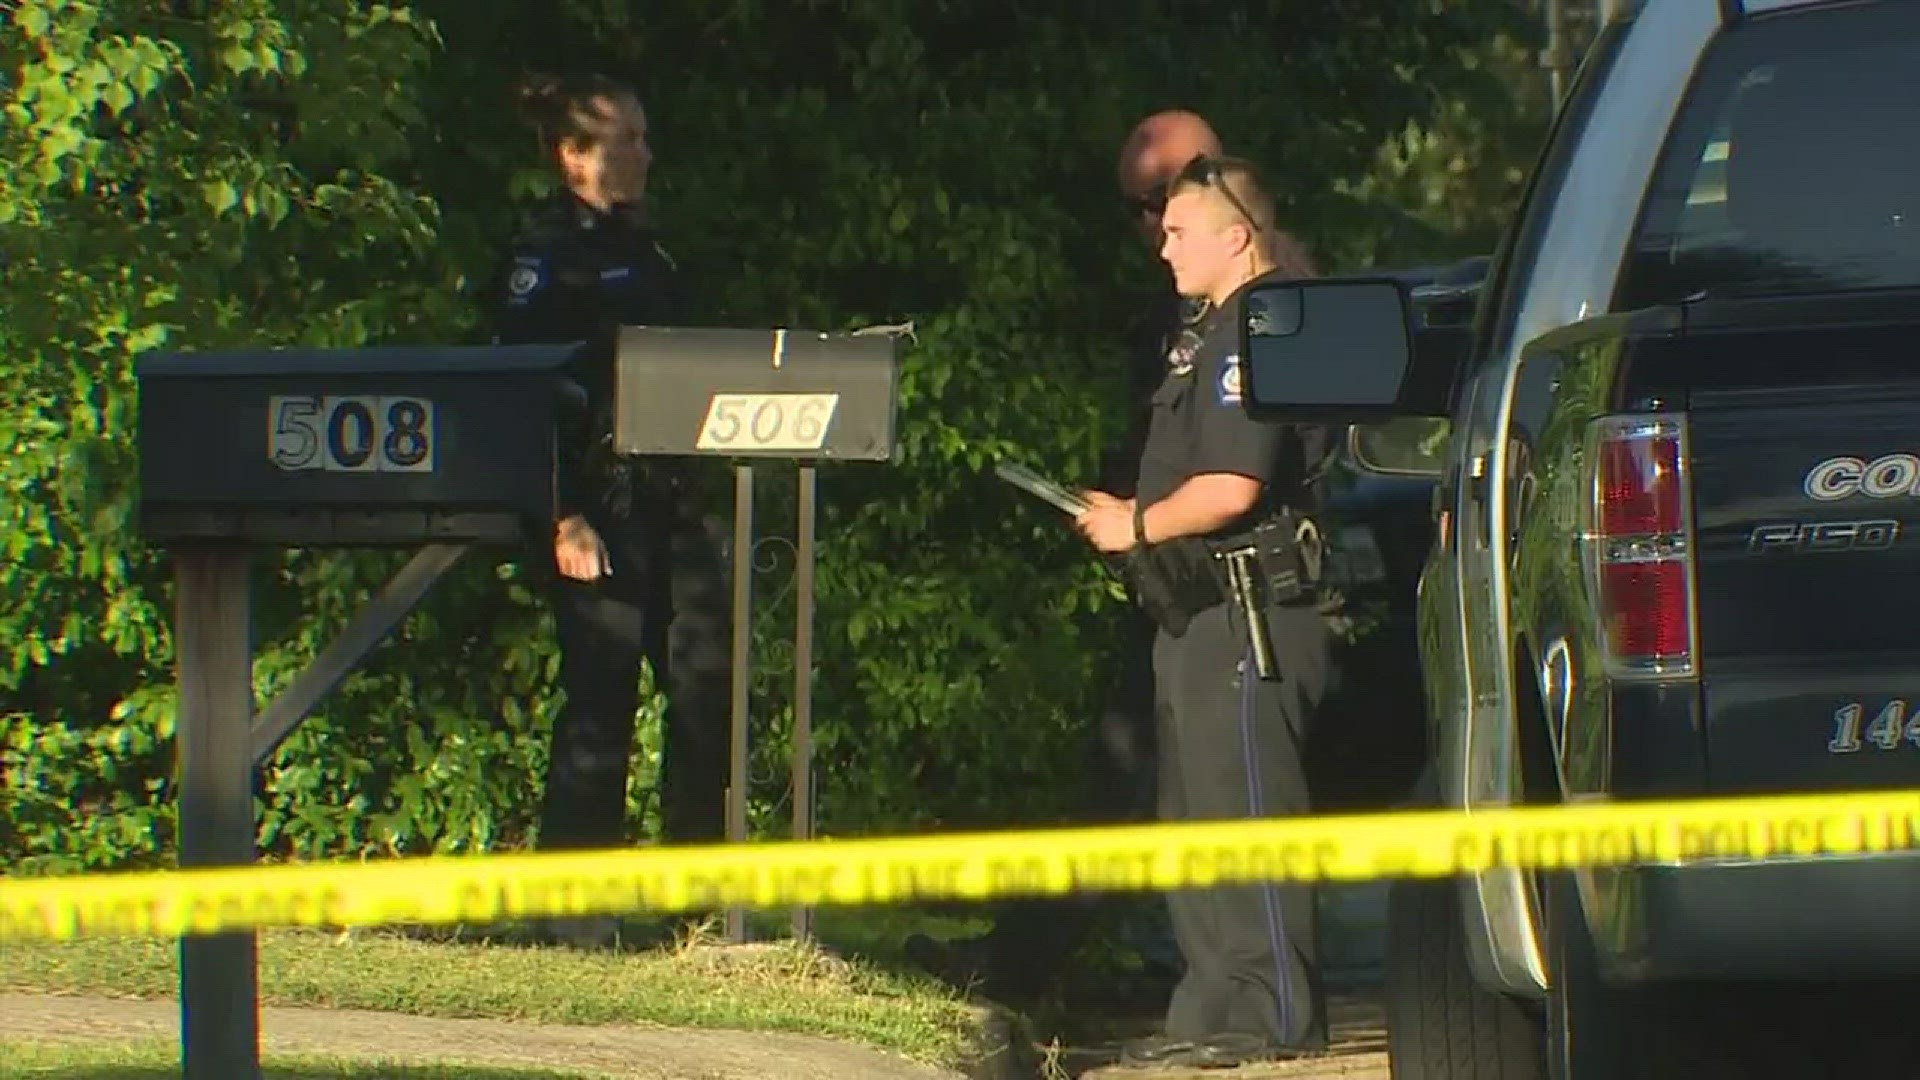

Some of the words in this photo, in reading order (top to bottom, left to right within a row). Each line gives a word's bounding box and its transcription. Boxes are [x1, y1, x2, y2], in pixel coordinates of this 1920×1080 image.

[276, 400, 428, 467] 508
[709, 398, 826, 444] 506
[1804, 454, 1920, 500] CO
[1749, 520, 1898, 554] F-150
